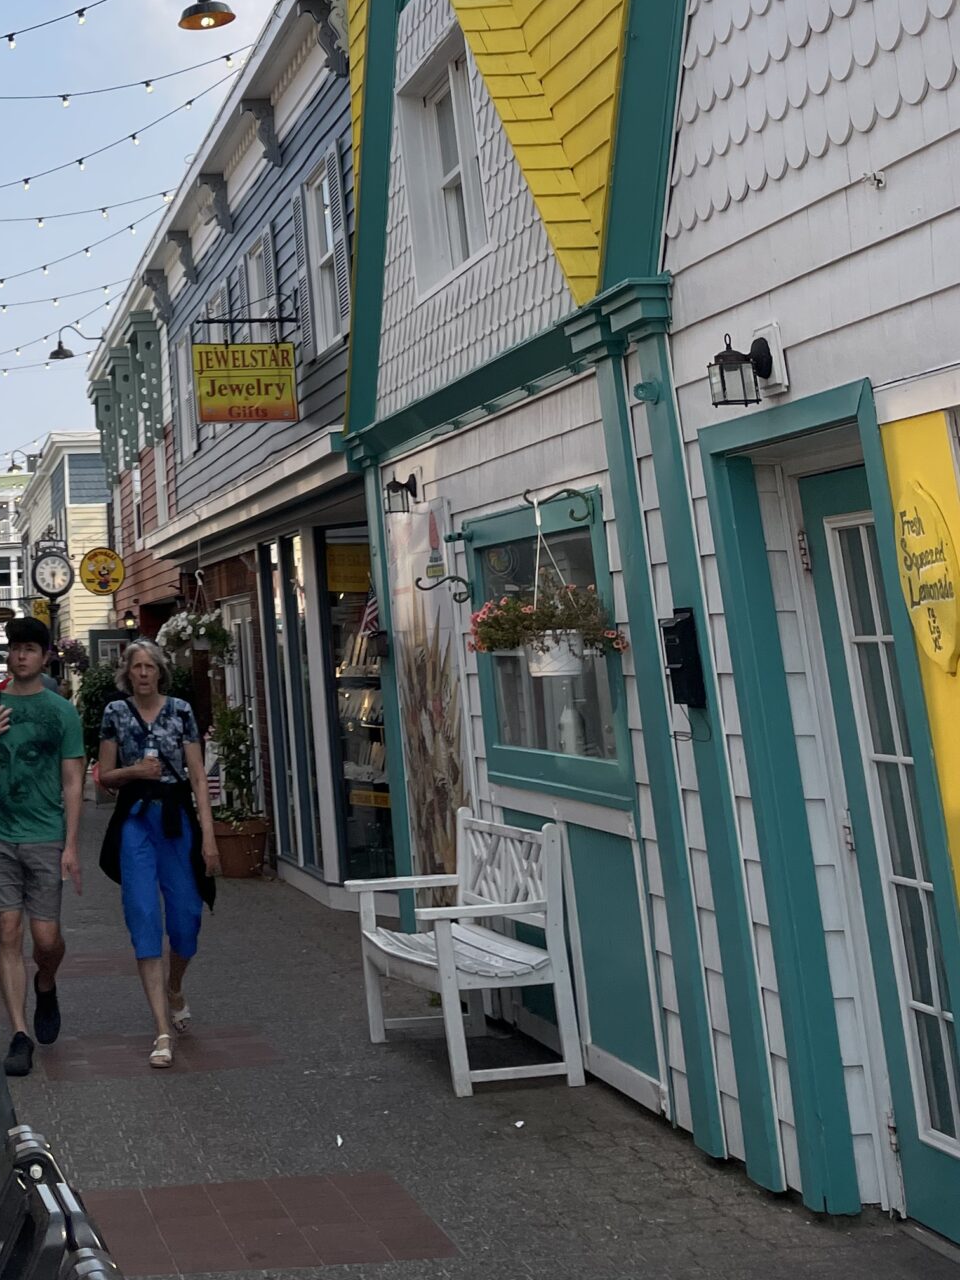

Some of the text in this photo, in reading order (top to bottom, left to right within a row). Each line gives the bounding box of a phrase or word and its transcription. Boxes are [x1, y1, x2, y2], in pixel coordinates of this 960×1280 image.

[198, 349, 292, 375] JEWELSTAR
[206, 378, 286, 401] Jewelry
[228, 405, 268, 419] Gifts
[899, 506, 925, 537] Fresh
[900, 537, 947, 580] Squeezed
[908, 574, 954, 608] Lemonade
